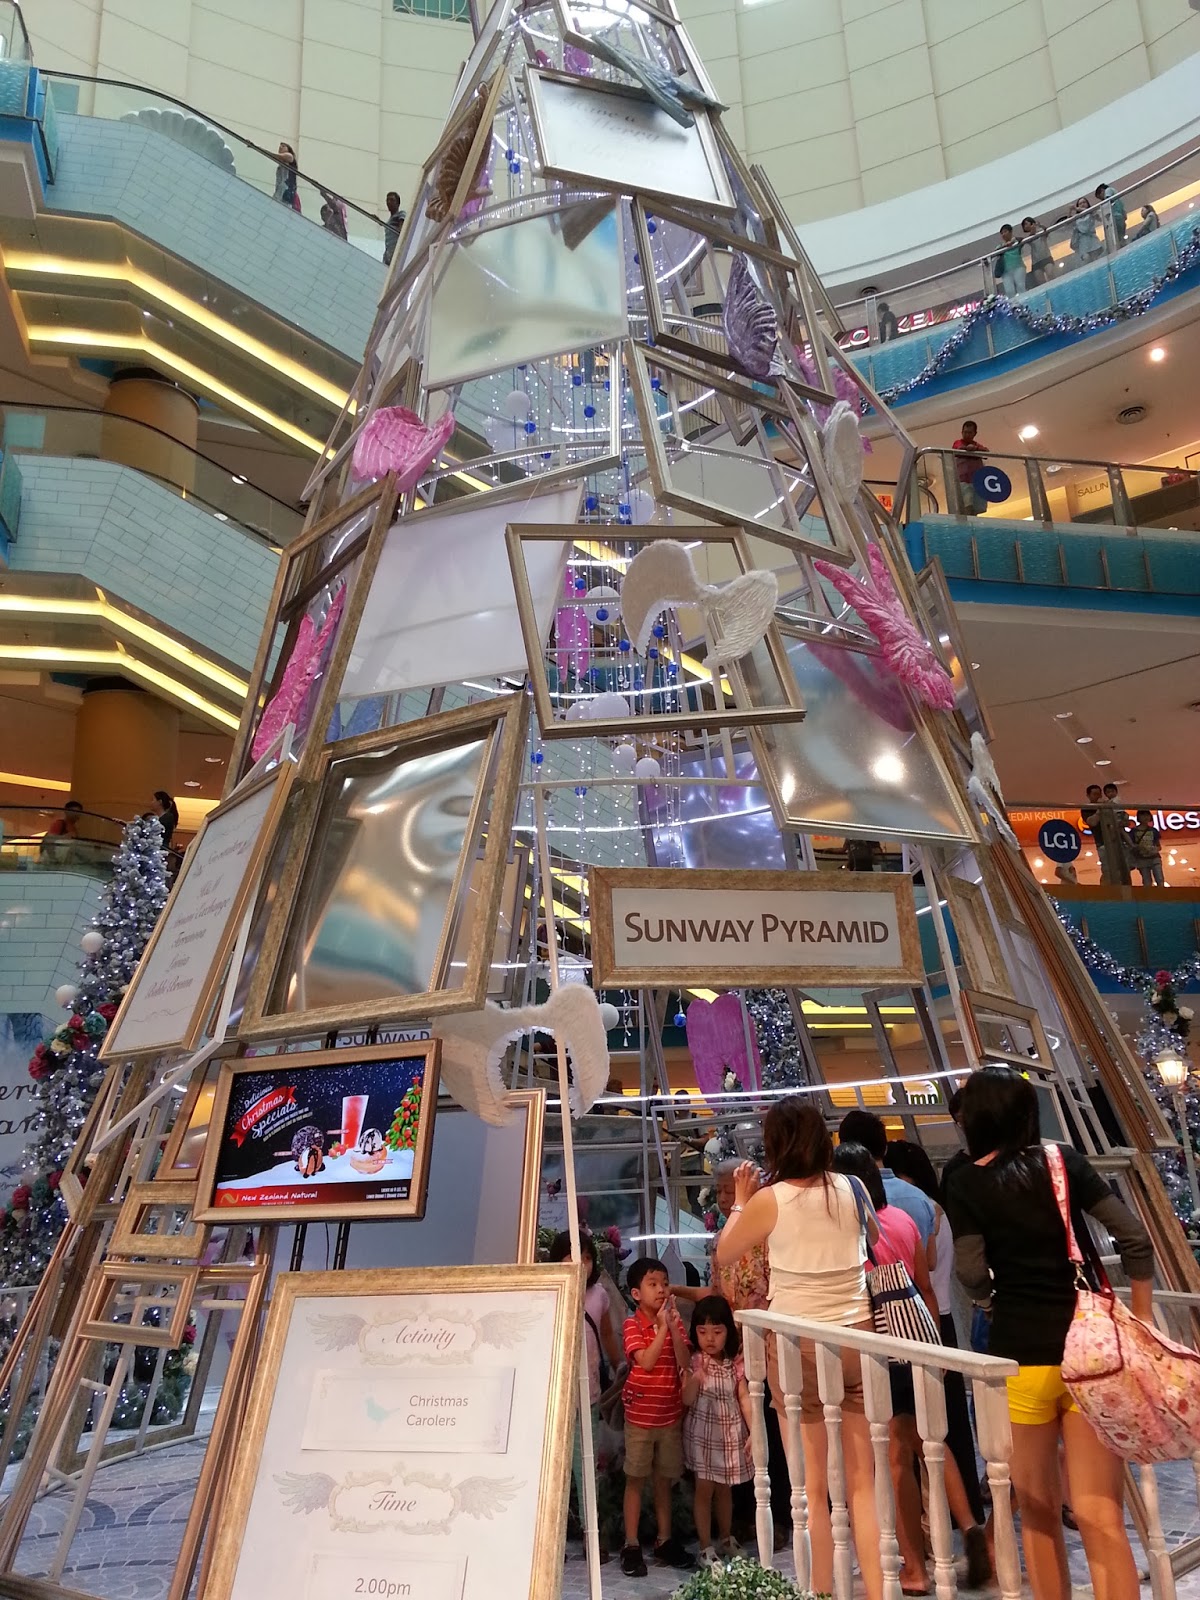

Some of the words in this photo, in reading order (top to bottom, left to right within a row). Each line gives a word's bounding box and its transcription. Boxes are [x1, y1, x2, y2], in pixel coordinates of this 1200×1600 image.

[983, 475, 1002, 493] G
[1043, 831, 1079, 850] LG1
[624, 912, 755, 943] SUNWAY
[760, 913, 889, 944] PYRAMID
[343, 1032, 417, 1046] SUWAY
[244, 1085, 275, 1109] Delicious
[241, 1095, 285, 1131] Christmas
[251, 1098, 299, 1140] Specials
[241, 1194, 258, 1202] New
[259, 1191, 289, 1201] Zealand
[290, 1190, 318, 1200] Natural
[381, 1325, 456, 1351] Activity
[409, 1394, 469, 1408] Christmas
[406, 1414, 457, 1427] Carolers
[368, 1490, 417, 1512] Time
[354, 1577, 411, 1599] 2.00pm
